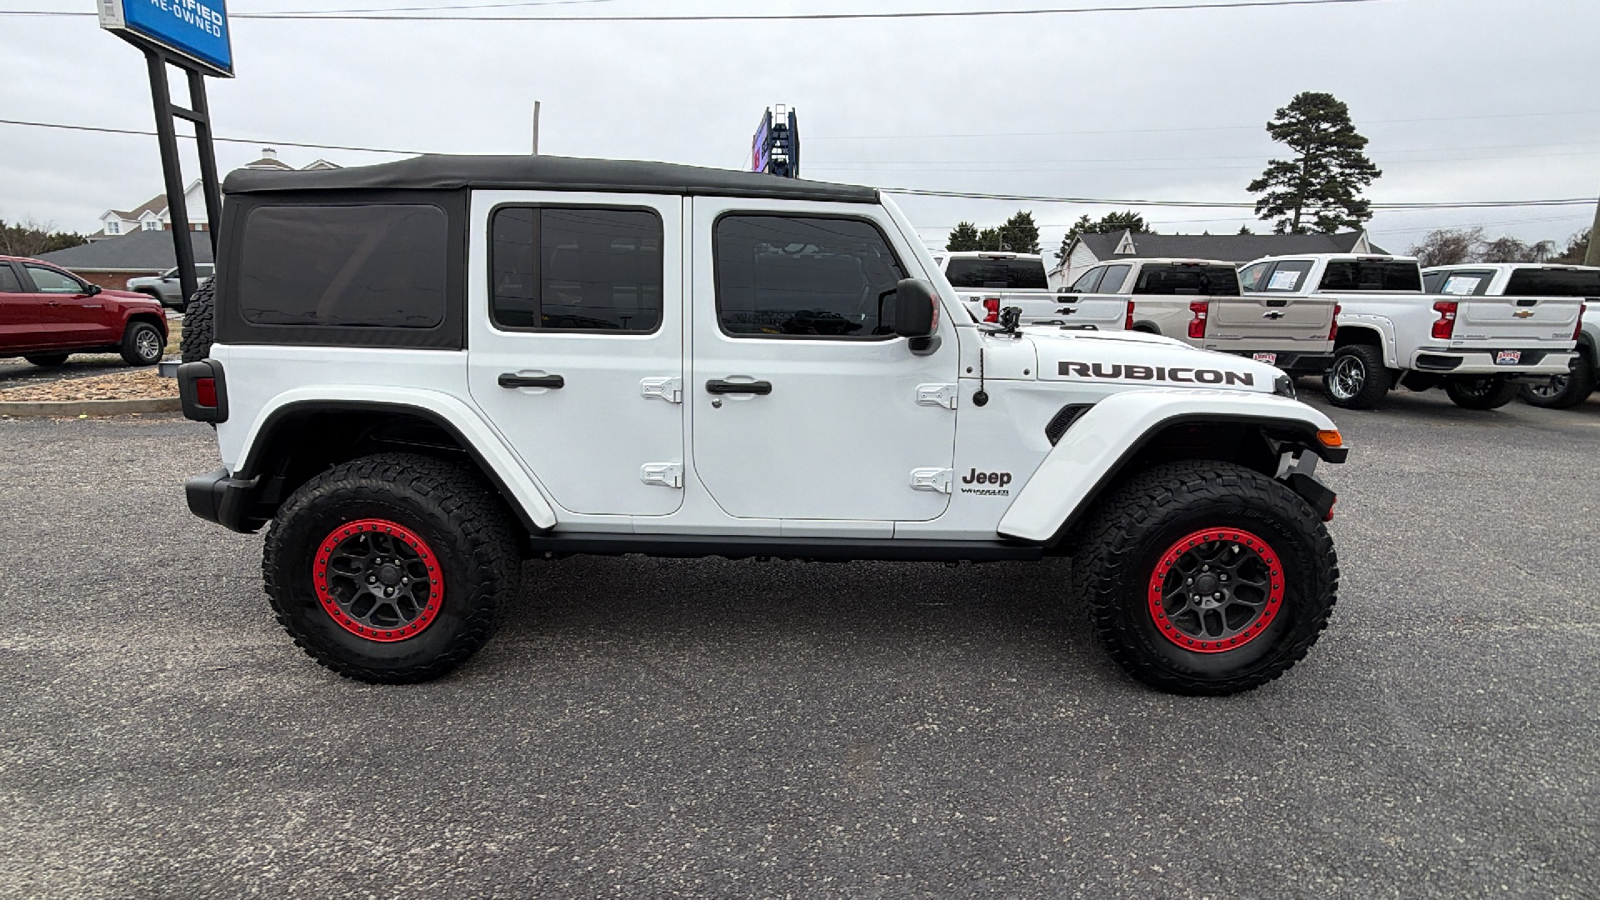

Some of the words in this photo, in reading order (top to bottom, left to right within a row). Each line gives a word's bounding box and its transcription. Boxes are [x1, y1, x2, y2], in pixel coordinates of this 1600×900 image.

[174, 0, 223, 26] IFIED
[1058, 361, 1254, 386] RUBICON
[962, 468, 1012, 488] Jeep
